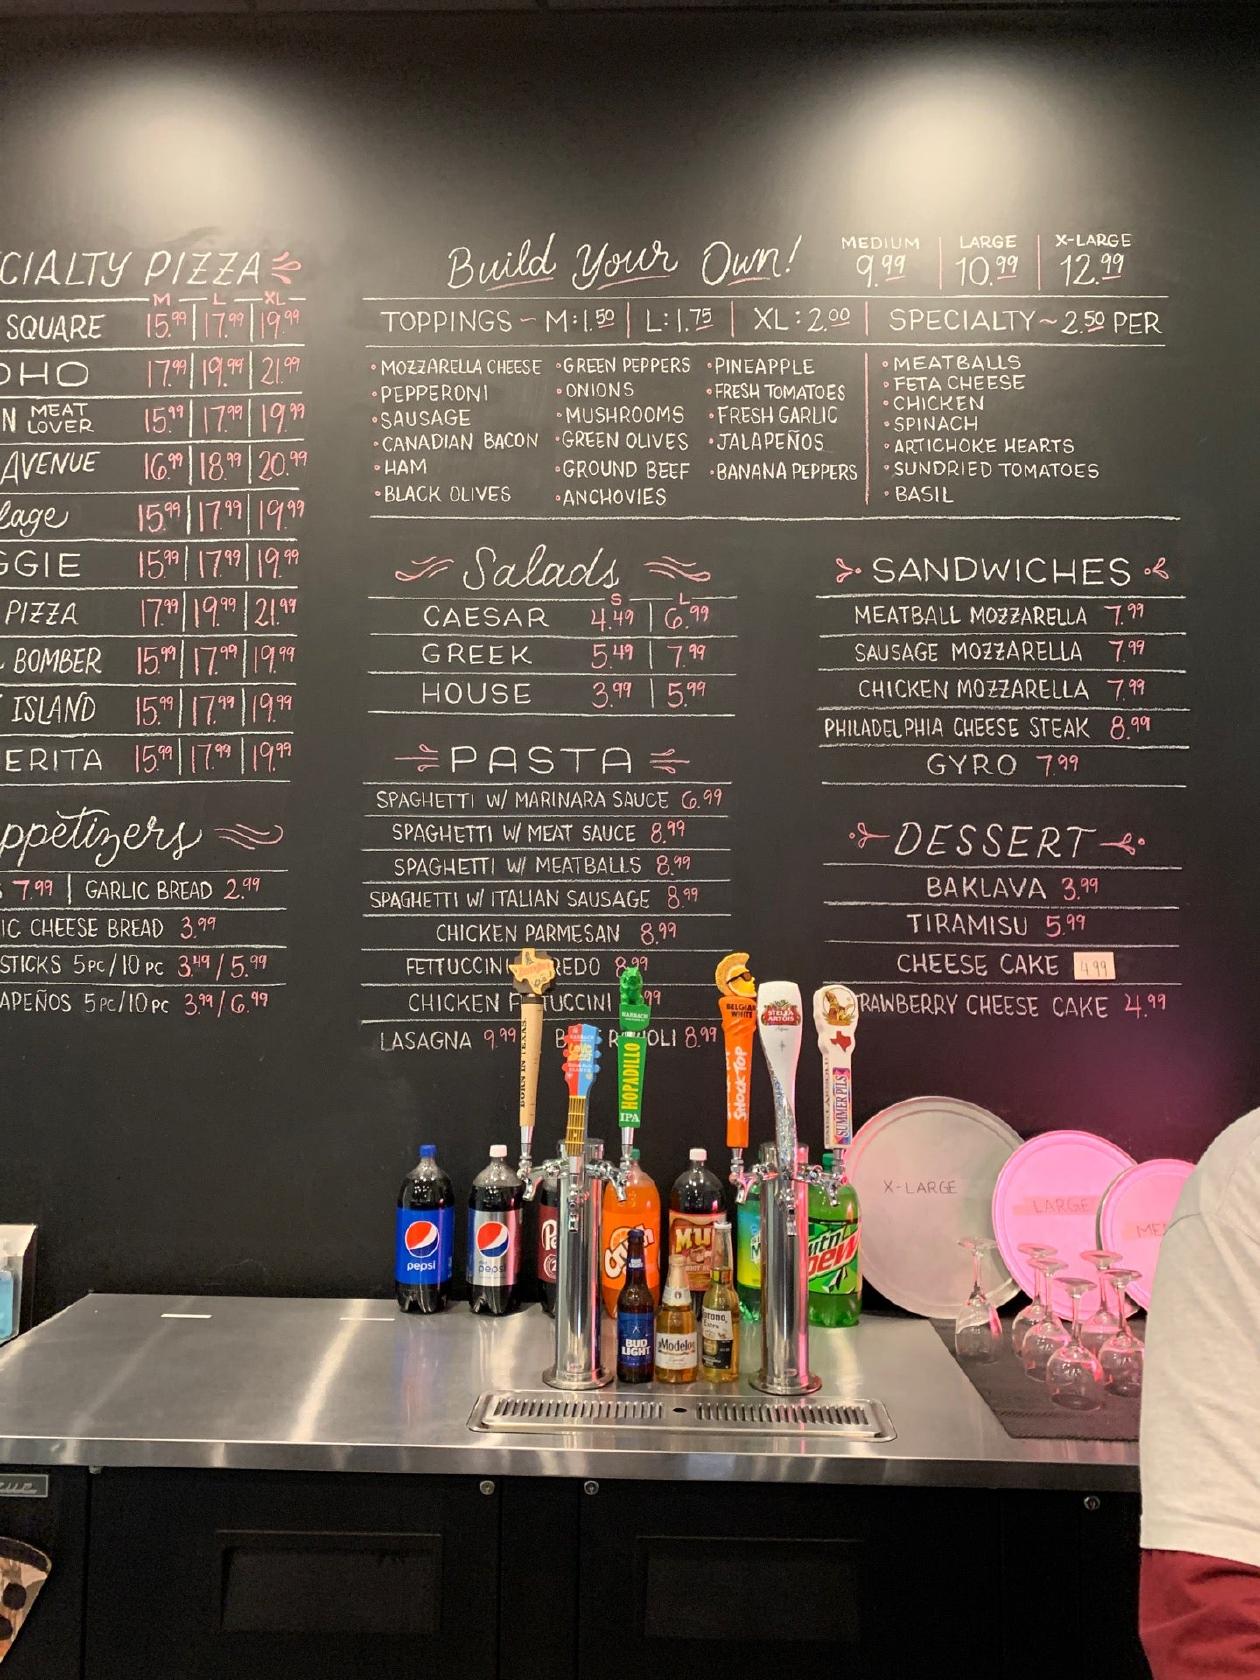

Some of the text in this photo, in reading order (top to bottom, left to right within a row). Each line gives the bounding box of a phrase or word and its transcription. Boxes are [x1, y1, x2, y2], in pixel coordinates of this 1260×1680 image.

[842, 234, 1131, 250] MEDIUM LARGE X-LARGE
[145, 250, 260, 285] PIZZA
[448, 233, 802, 290] Build Your Own!
[857, 253, 1124, 288] 9.99 10.99 12.99
[153, 291, 285, 306] M L XL
[7, 309, 299, 342] SQUARE 15.99 17.99 19.99
[381, 310, 512, 333] TOPPINGS
[890, 308, 1162, 334] SPECIALTY 2.50 PER
[382, 358, 542, 375] MOZZARELLA CHEESE
[564, 357, 690, 373] GREEN PEPPERS
[715, 358, 814, 375] PINEAPPLE
[894, 355, 1021, 371] MEATBALLS
[566, 382, 633, 397] ONIONS
[715, 383, 845, 401] FRESH TOMATOES
[894, 375, 1025, 391] FETA CHEESE
[381, 384, 487, 403] PEPPERONI
[894, 396, 983, 411] CHICKEN
[31, 403, 88, 417] MEAT
[381, 409, 470, 429] SAUSAGE
[566, 406, 683, 423] MUSHROOMS
[718, 406, 837, 424] FRESH GARLIC
[28, 419, 94, 434] LOVER
[894, 416, 977, 432] SPINACH
[383, 432, 538, 452] CANADIAN BACON
[563, 431, 688, 450] GREEN OLIVES
[716, 432, 823, 451] JALAPEÑOS
[895, 438, 1074, 454] ARTICHOKE HEARTS
[0, 451, 307, 485] AVENUE 16.99 18.99 20.99
[385, 459, 426, 475] HAM
[563, 460, 690, 479] GROUND BEEF
[716, 462, 857, 480] BANANA PEPPERS
[895, 460, 1099, 478] SUNDRIED TOMATOES
[385, 486, 511, 502] BLACK OLIVES
[563, 488, 666, 506] ANCHOVIES
[896, 486, 954, 503] BASIL
[463, 544, 619, 590] Salads
[873, 557, 1130, 586] SANDWICHES
[5, 600, 78, 625] PIZZA
[424, 605, 709, 632] CAESAR 4.49 6.99
[855, 603, 1144, 626] MEATBALL MOZZARELLA 7.99
[14, 647, 101, 674] BOMBER
[422, 643, 706, 669] GREEK 5.49 7.99
[855, 640, 1144, 662] SAUSAGE MOZZARELLA 7.99
[423, 681, 705, 708] HOUSE 3.99 5.99
[859, 679, 1145, 700] CHICKEN MOZZARELLA 7.99
[12, 692, 95, 724] ISLAND
[825, 716, 1150, 740] PHILADELPHIA CHEESE STEAK 8.99
[451, 746, 631, 774] PASTA
[927, 753, 1078, 776] GYRO 7.99
[377, 789, 722, 809] SPAGHETTI W/ MARINARA SAUCE 6.99
[393, 820, 684, 843] SPAGHETTI W/ MEAT SAUCE 8.99
[895, 822, 1096, 858] DESSERT
[395, 855, 690, 876] SPAGHETTI W/ MEATBALLS 8.99
[86, 877, 260, 900] GARLIC BREAD 2.99
[370, 886, 697, 909] SPAGHETTI W/ ITALIAN SAUSAGE 8.99
[927, 877, 1098, 900] BAKLAVA 3.99
[31, 916, 216, 939] CHEESE BREAD 3.99
[437, 922, 676, 945] CHICKEN PARMESAN 8.99
[907, 913, 1085, 937] TIRAMISU 5.99
[898, 953, 1058, 976] CHEESE CAKE
[381, 1028, 516, 1051] LASAGNA 9.99
[621, 1042, 640, 1110] HOPADILLO
[836, 1076, 848, 1137] SUMMER PILS
[620, 1112, 640, 1122] IPA
[883, 1180, 958, 1194] X-LARGE
[1033, 1199, 1088, 1213] LARGE
[407, 1260, 436, 1271] pepsi
[622, 1346, 650, 1356] LIGHT
[626, 1339, 648, 1347] BUD
